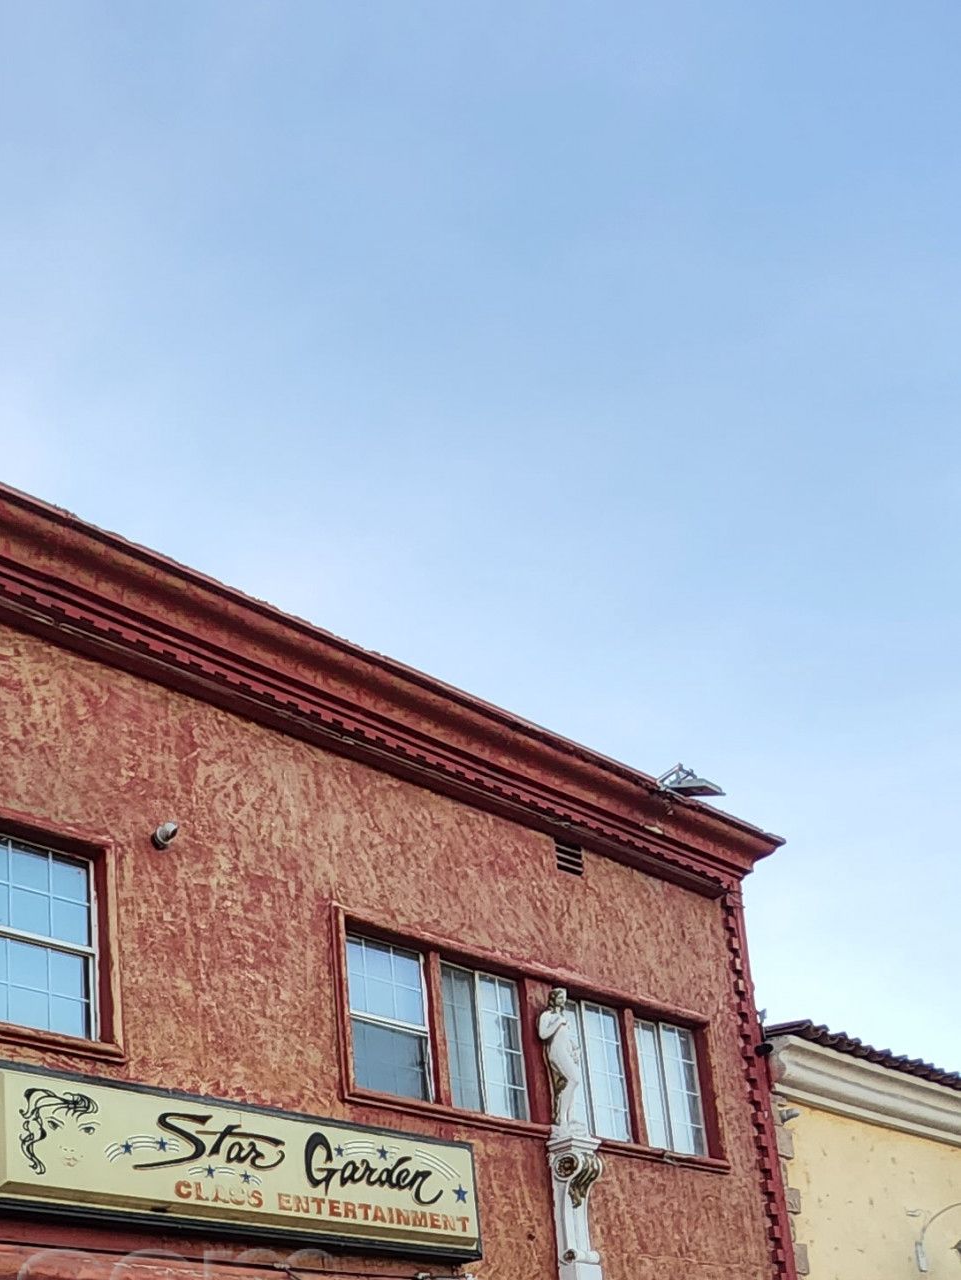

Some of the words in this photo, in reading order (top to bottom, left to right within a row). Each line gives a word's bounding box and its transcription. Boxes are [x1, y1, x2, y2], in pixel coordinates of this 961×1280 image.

[133, 1111, 285, 1172] Star
[304, 1131, 445, 1206] Garden
[277, 1191, 471, 1234] ENTERTAINMENT
